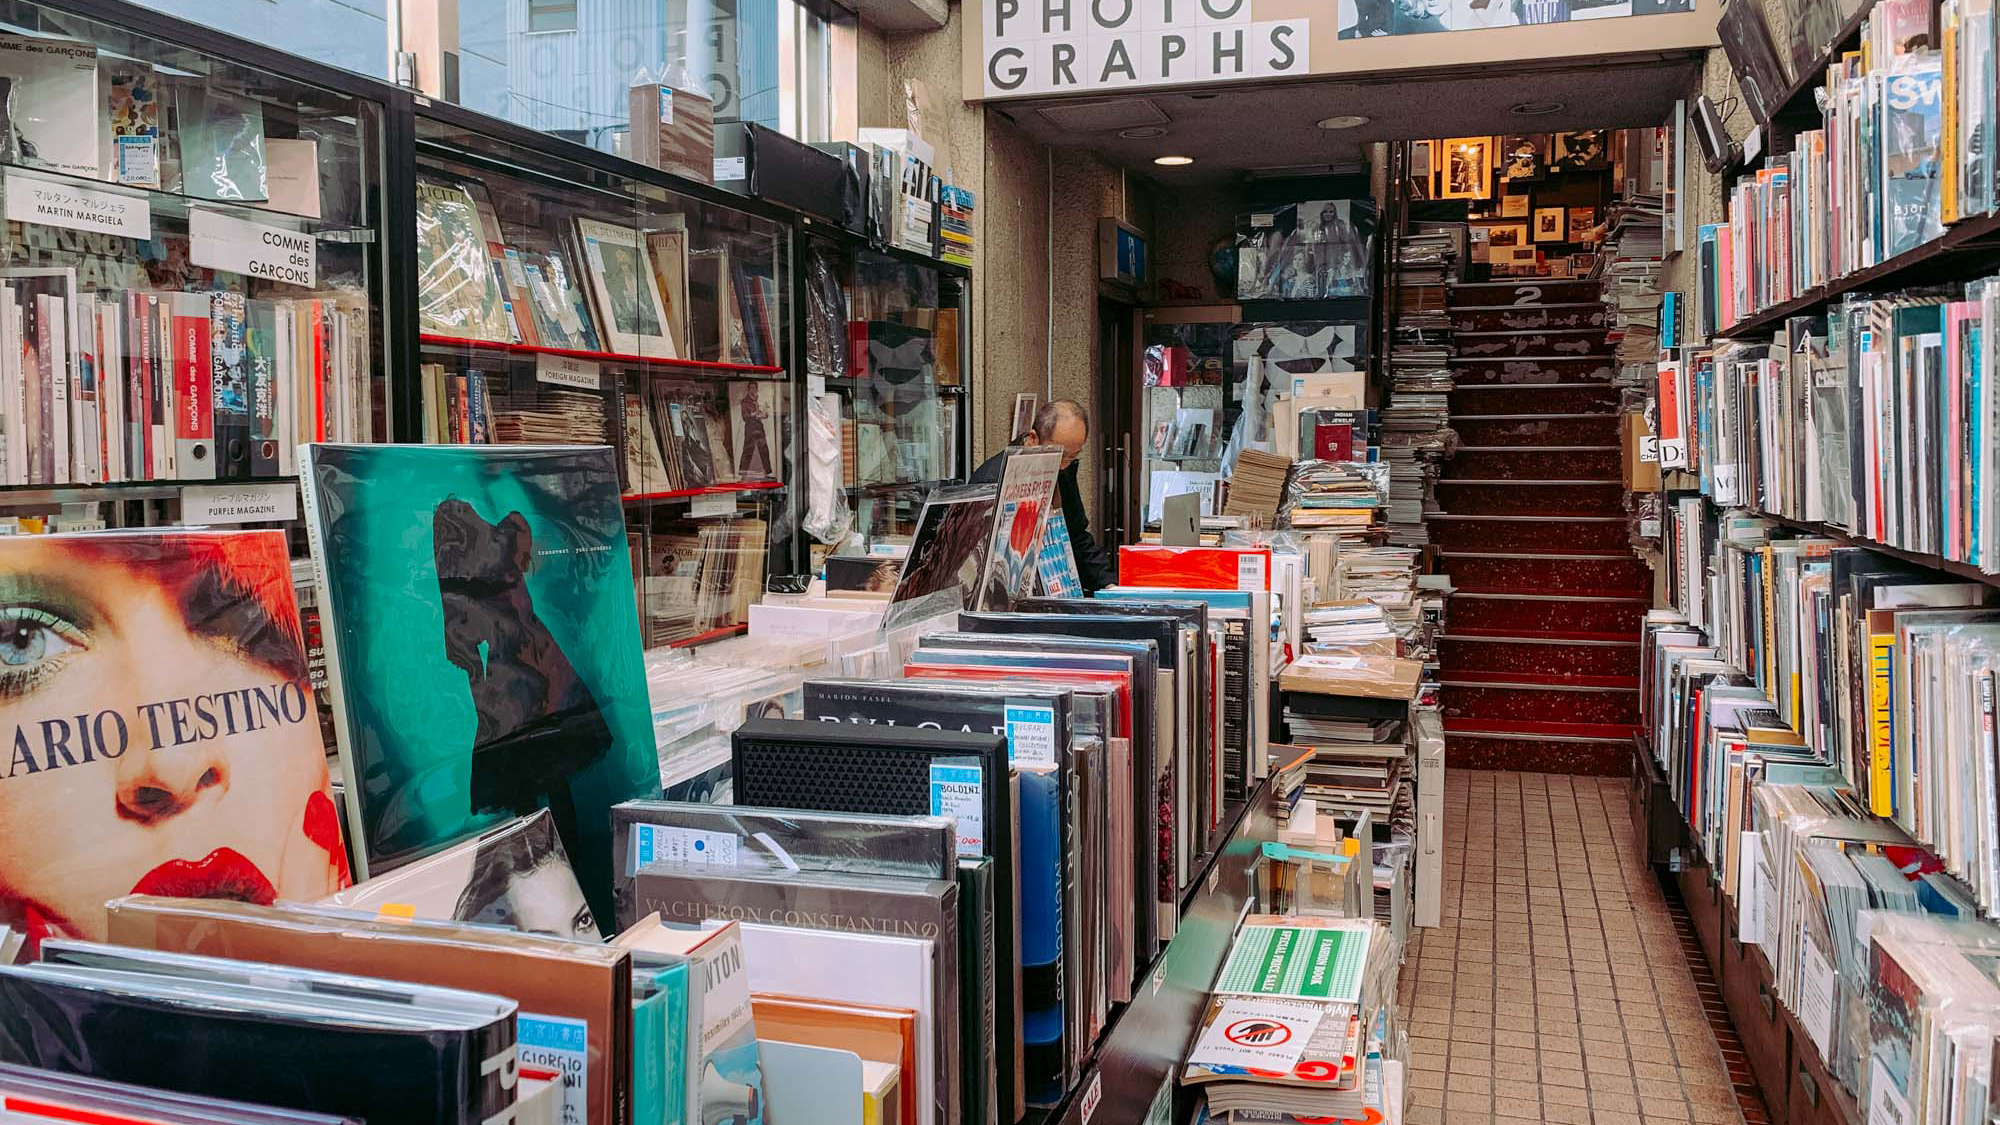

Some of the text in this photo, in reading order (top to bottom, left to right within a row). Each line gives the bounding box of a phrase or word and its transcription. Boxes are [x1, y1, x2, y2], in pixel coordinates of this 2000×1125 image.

[996, 0, 1243, 37] PHOTO
[988, 26, 1295, 91] GRAPHS
[37, 204, 124, 227] MARTIN MARGIELA
[262, 230, 310, 254] COMME
[248, 259, 310, 286] GARÇONS
[288, 251, 310, 267] des
[1514, 286, 1542, 306] 2
[188, 328, 197, 364] COMME
[545, 370, 595, 386] FOREIGN MAGAZINE
[187, 385, 199, 431] GARÇONS
[208, 505, 276, 516] PURPLE MAGAZINE
[818, 693, 858, 701] MARION
[0, 679, 308, 779] ARIO TESTINO
[940, 784, 980, 795] BOLDINI
[645, 897, 763, 924] VACHERON
[1274, 929, 1293, 957] SPECIAL
[1318, 938, 1334, 967] FASHION
[521, 1050, 582, 1073] GIORGIO
[1082, 1079, 1100, 1119] SALE
